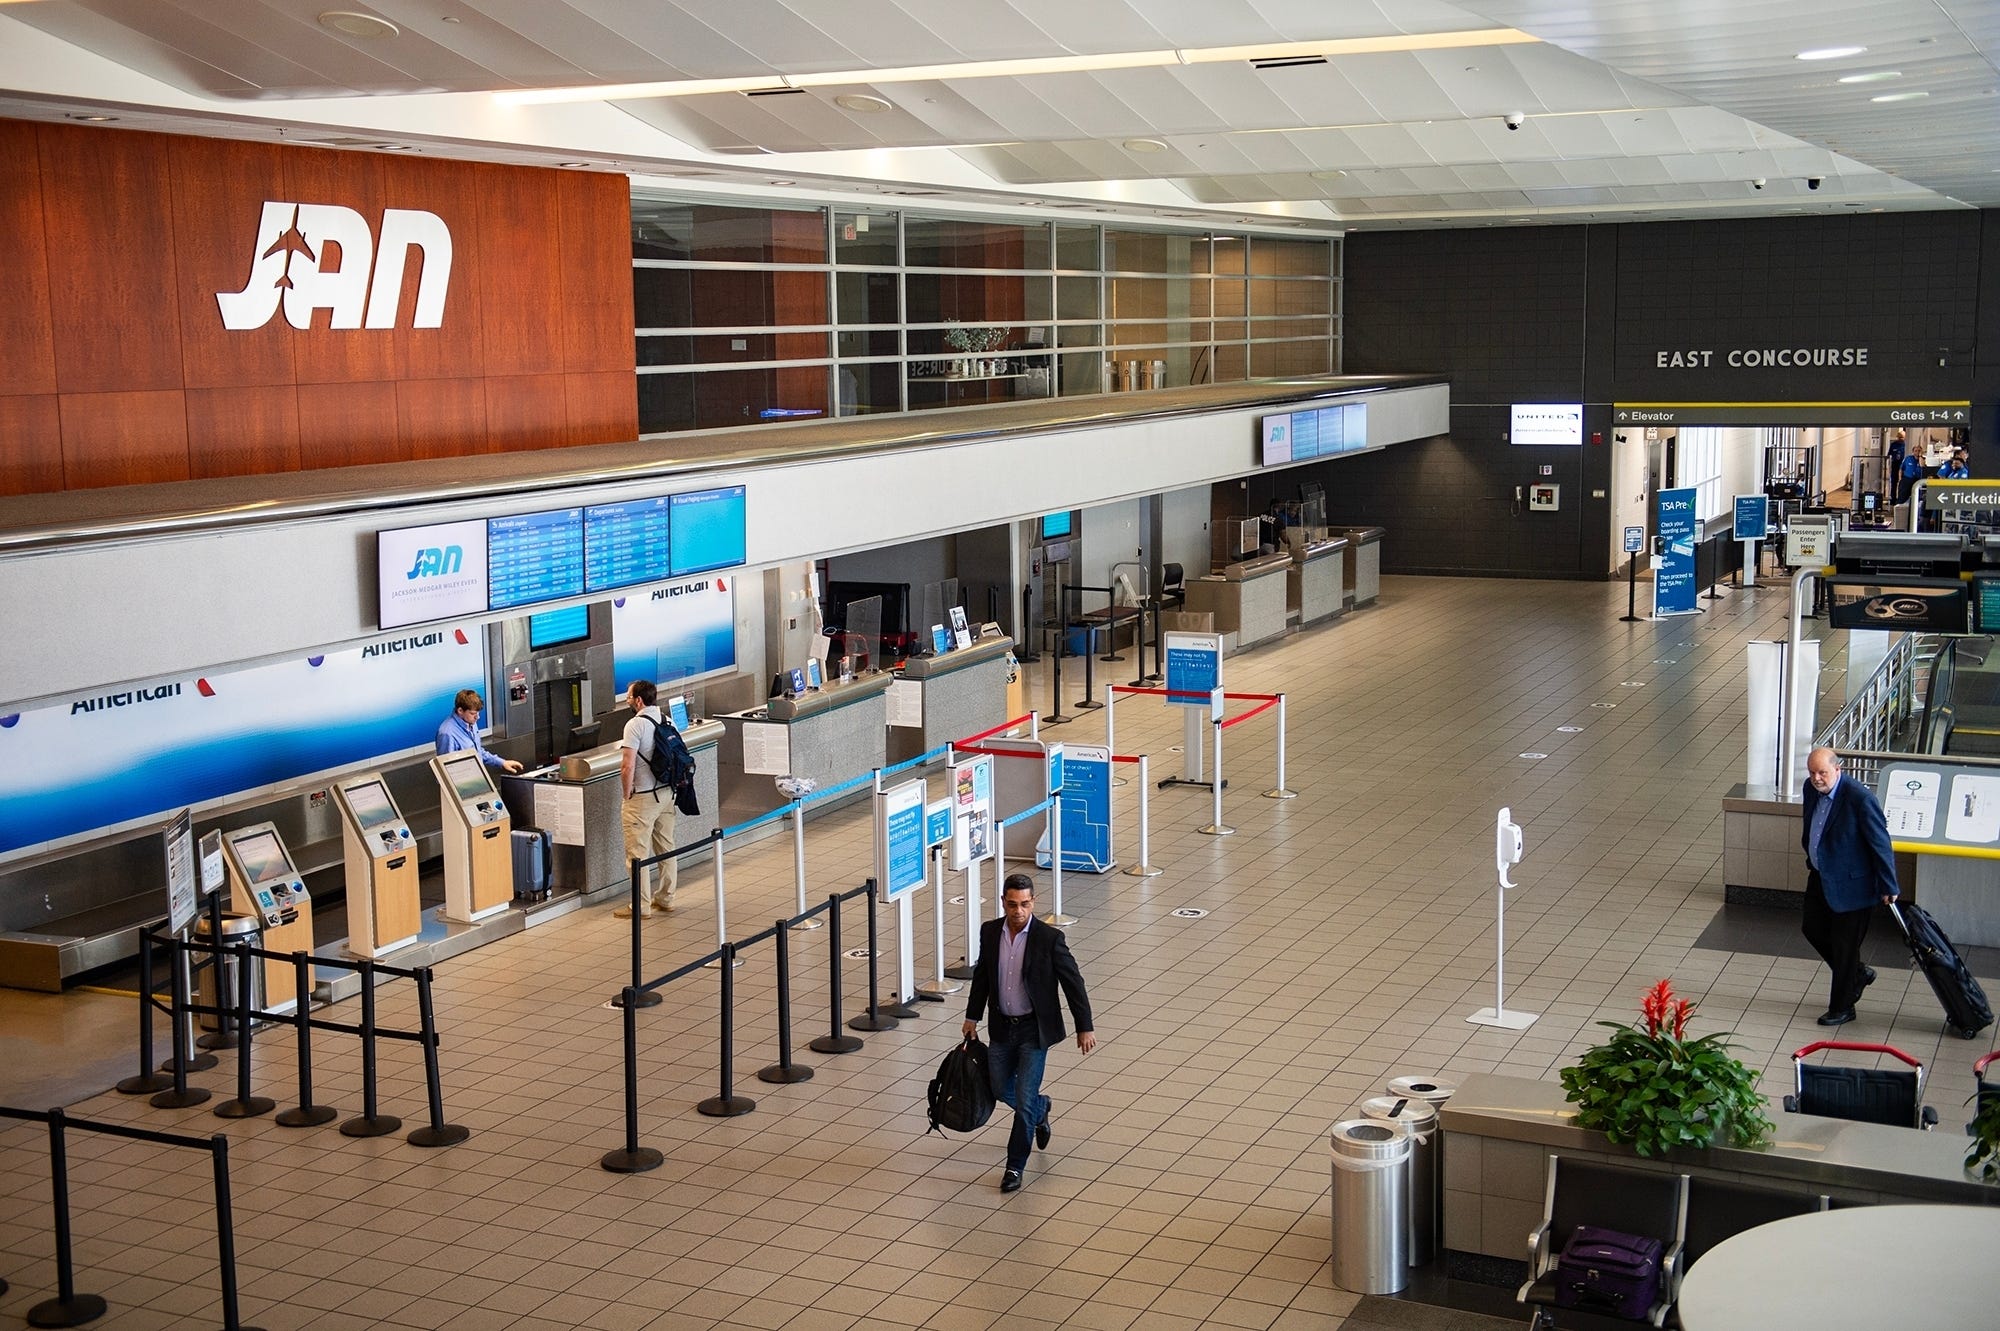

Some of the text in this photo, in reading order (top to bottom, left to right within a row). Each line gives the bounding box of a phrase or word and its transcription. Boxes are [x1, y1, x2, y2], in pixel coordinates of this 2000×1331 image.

[215, 201, 453, 330] JAN
[1656, 348, 1868, 368] EAST CONCOURSE
[1631, 411, 1674, 421] Elevator
[1890, 410, 1949, 421] Gates 1-4
[1952, 491, 2000, 505] Ticketi
[1661, 502, 1675, 511] TSA
[1674, 520, 1684, 528] your
[406, 544, 464, 580] JAN
